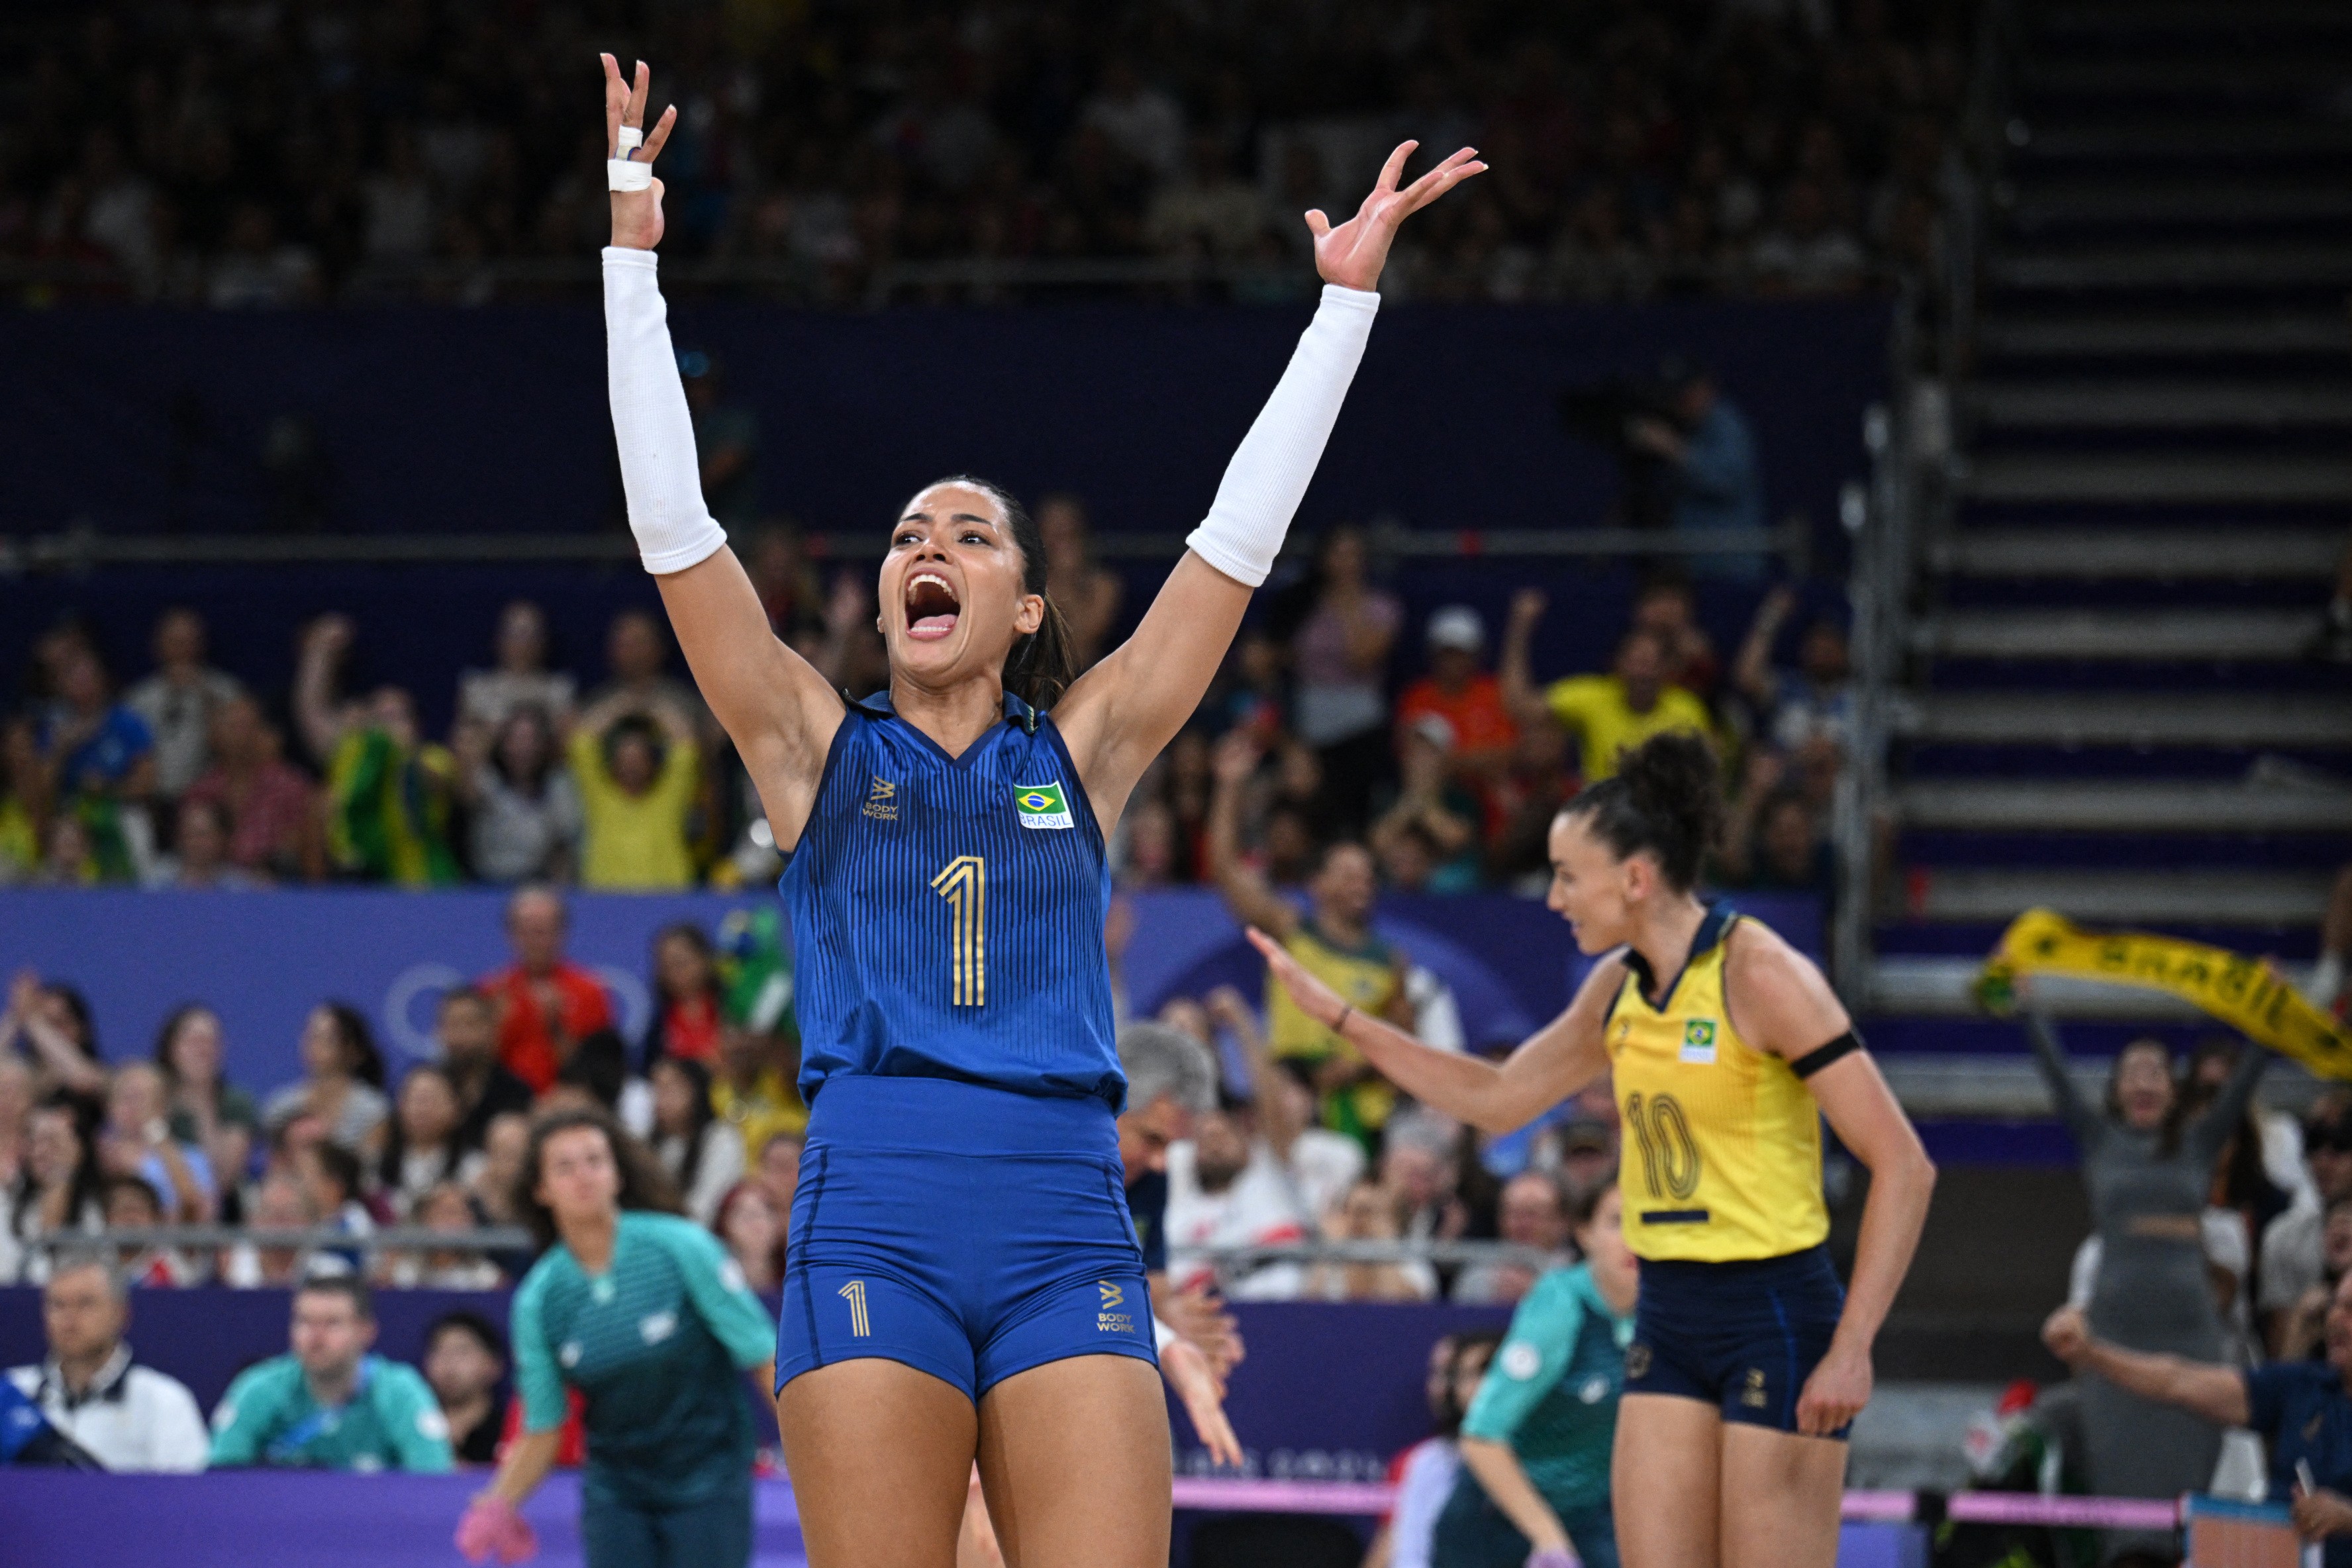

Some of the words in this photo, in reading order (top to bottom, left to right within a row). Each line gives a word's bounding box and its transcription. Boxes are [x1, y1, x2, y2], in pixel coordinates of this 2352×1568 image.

[862, 808, 899, 820] WORK
[865, 802, 899, 813] BODY
[1020, 812, 1071, 826] BRASIL
[930, 855, 985, 1006] 1
[1627, 1090, 1700, 1201] 10
[838, 1280, 870, 1338] 1
[1099, 1312, 1132, 1324] BODY
[1097, 1322, 1136, 1335] WORK
